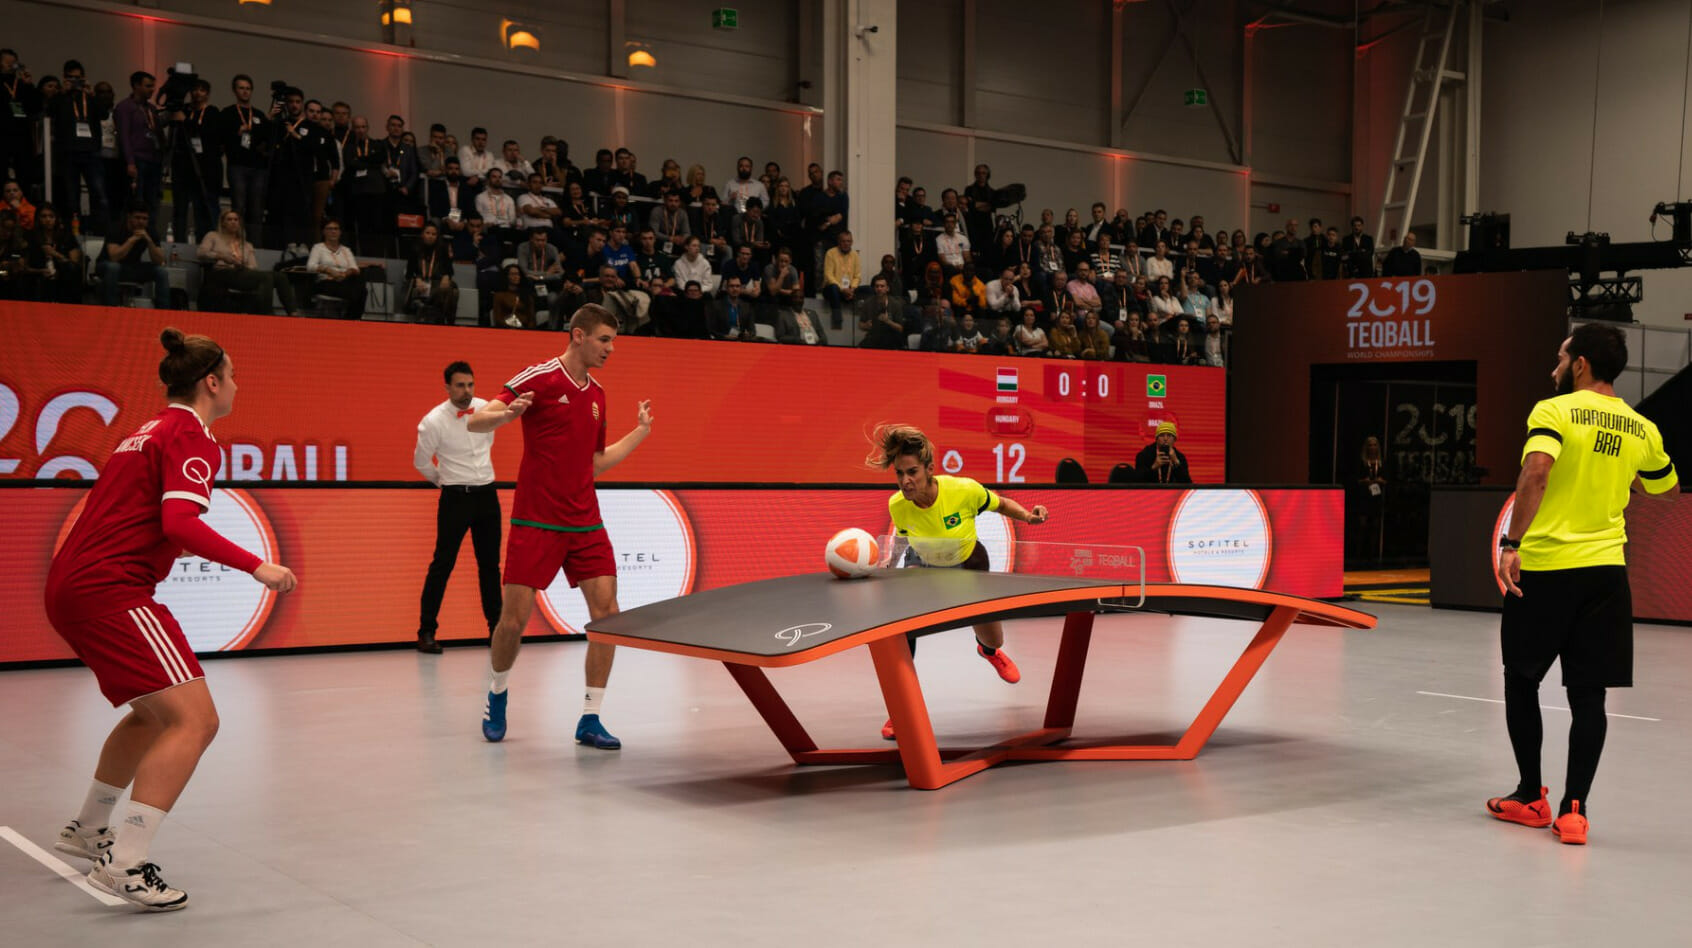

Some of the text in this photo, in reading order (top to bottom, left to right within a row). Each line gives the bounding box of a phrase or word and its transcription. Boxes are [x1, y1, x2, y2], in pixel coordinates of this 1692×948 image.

[1345, 319, 1436, 349] TEQBALL
[1570, 408, 1647, 440] MARQUINHOS
[1592, 430, 1623, 457] BRA
[992, 442, 1026, 483] 12
[1187, 539, 1249, 549] SOFITEL
